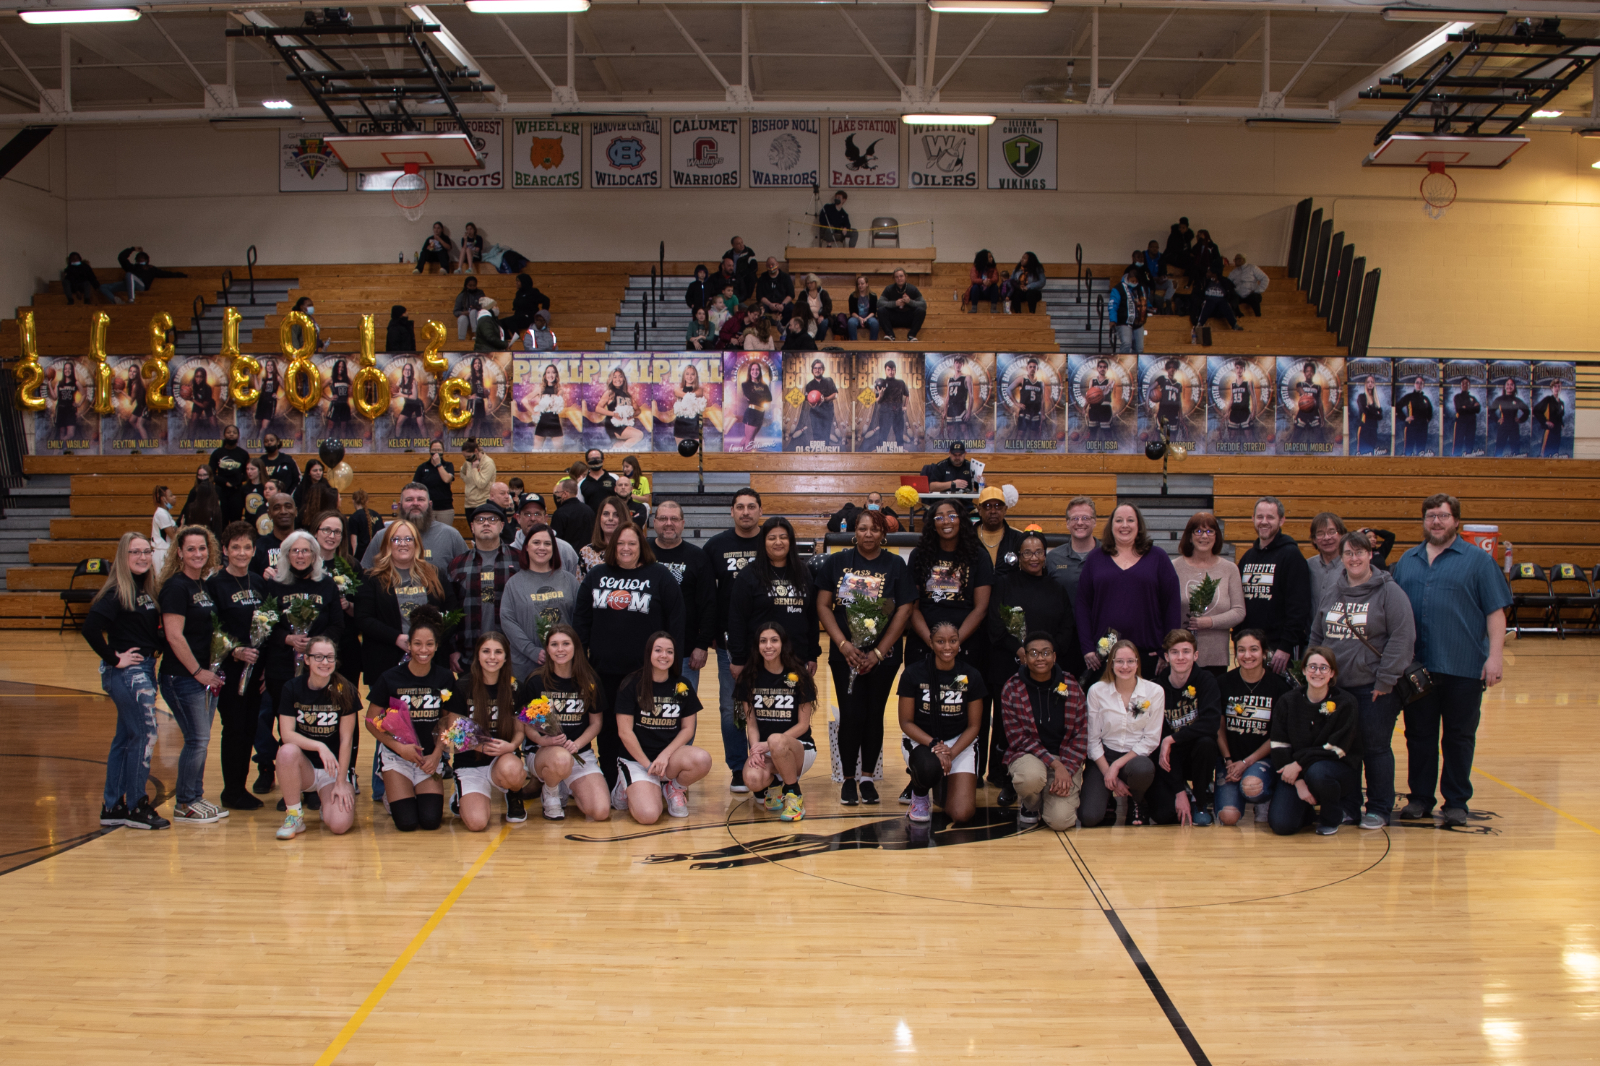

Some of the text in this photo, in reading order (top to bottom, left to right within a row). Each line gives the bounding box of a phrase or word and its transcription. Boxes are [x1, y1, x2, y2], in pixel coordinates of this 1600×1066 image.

[515, 121, 580, 136] WHEELER
[593, 121, 660, 135] HANOVER CENTRAL
[673, 120, 738, 134] CALUMET
[752, 120, 818, 134] BISHOP NOLL
[832, 120, 897, 135] LAKE STATION
[913, 124, 976, 136] WHITING
[437, 172, 501, 186] INGOTS
[515, 171, 580, 186] BEARCATS
[595, 170, 658, 186] WILDCATS
[673, 170, 738, 186] WARRIORS
[752, 170, 818, 185] WARRIORS
[832, 170, 896, 186] EAGLES
[912, 172, 976, 186] OILERS
[999, 178, 1046, 189] VIKINGS
[1030, 391, 1036, 401] 5
[1168, 390, 1176, 400] 14
[47, 440, 90, 449] EMILY VASILAK
[113, 439, 159, 449] PEYTON WILLIS
[180, 440, 192, 448] XYA
[247, 440, 262, 448] ELLA
[389, 439, 430, 448] KELSEY PRICE
[478, 438, 503, 447] ESQUIVEL
[1005, 440, 1057, 449] ALLEN RESENDEZ
[1086, 441, 1118, 450] ODEH ISSA
[1216, 443, 1265, 451] FREDDIE STREZO
[1284, 443, 1334, 452] DAREON MOBLEY
[843, 567, 871, 577] CLASS
[1243, 564, 1276, 573] GRIFFITH
[599, 576, 650, 591] senior
[531, 591, 564, 602] SENIOR
[609, 595, 629, 604] 2022
[774, 598, 804, 606] SENIOR
[756, 709, 792, 718] SENIORS
[641, 717, 677, 726] SENIORS
[1227, 718, 1267, 729] PANTHERS
[298, 723, 336, 734] SENIORS
